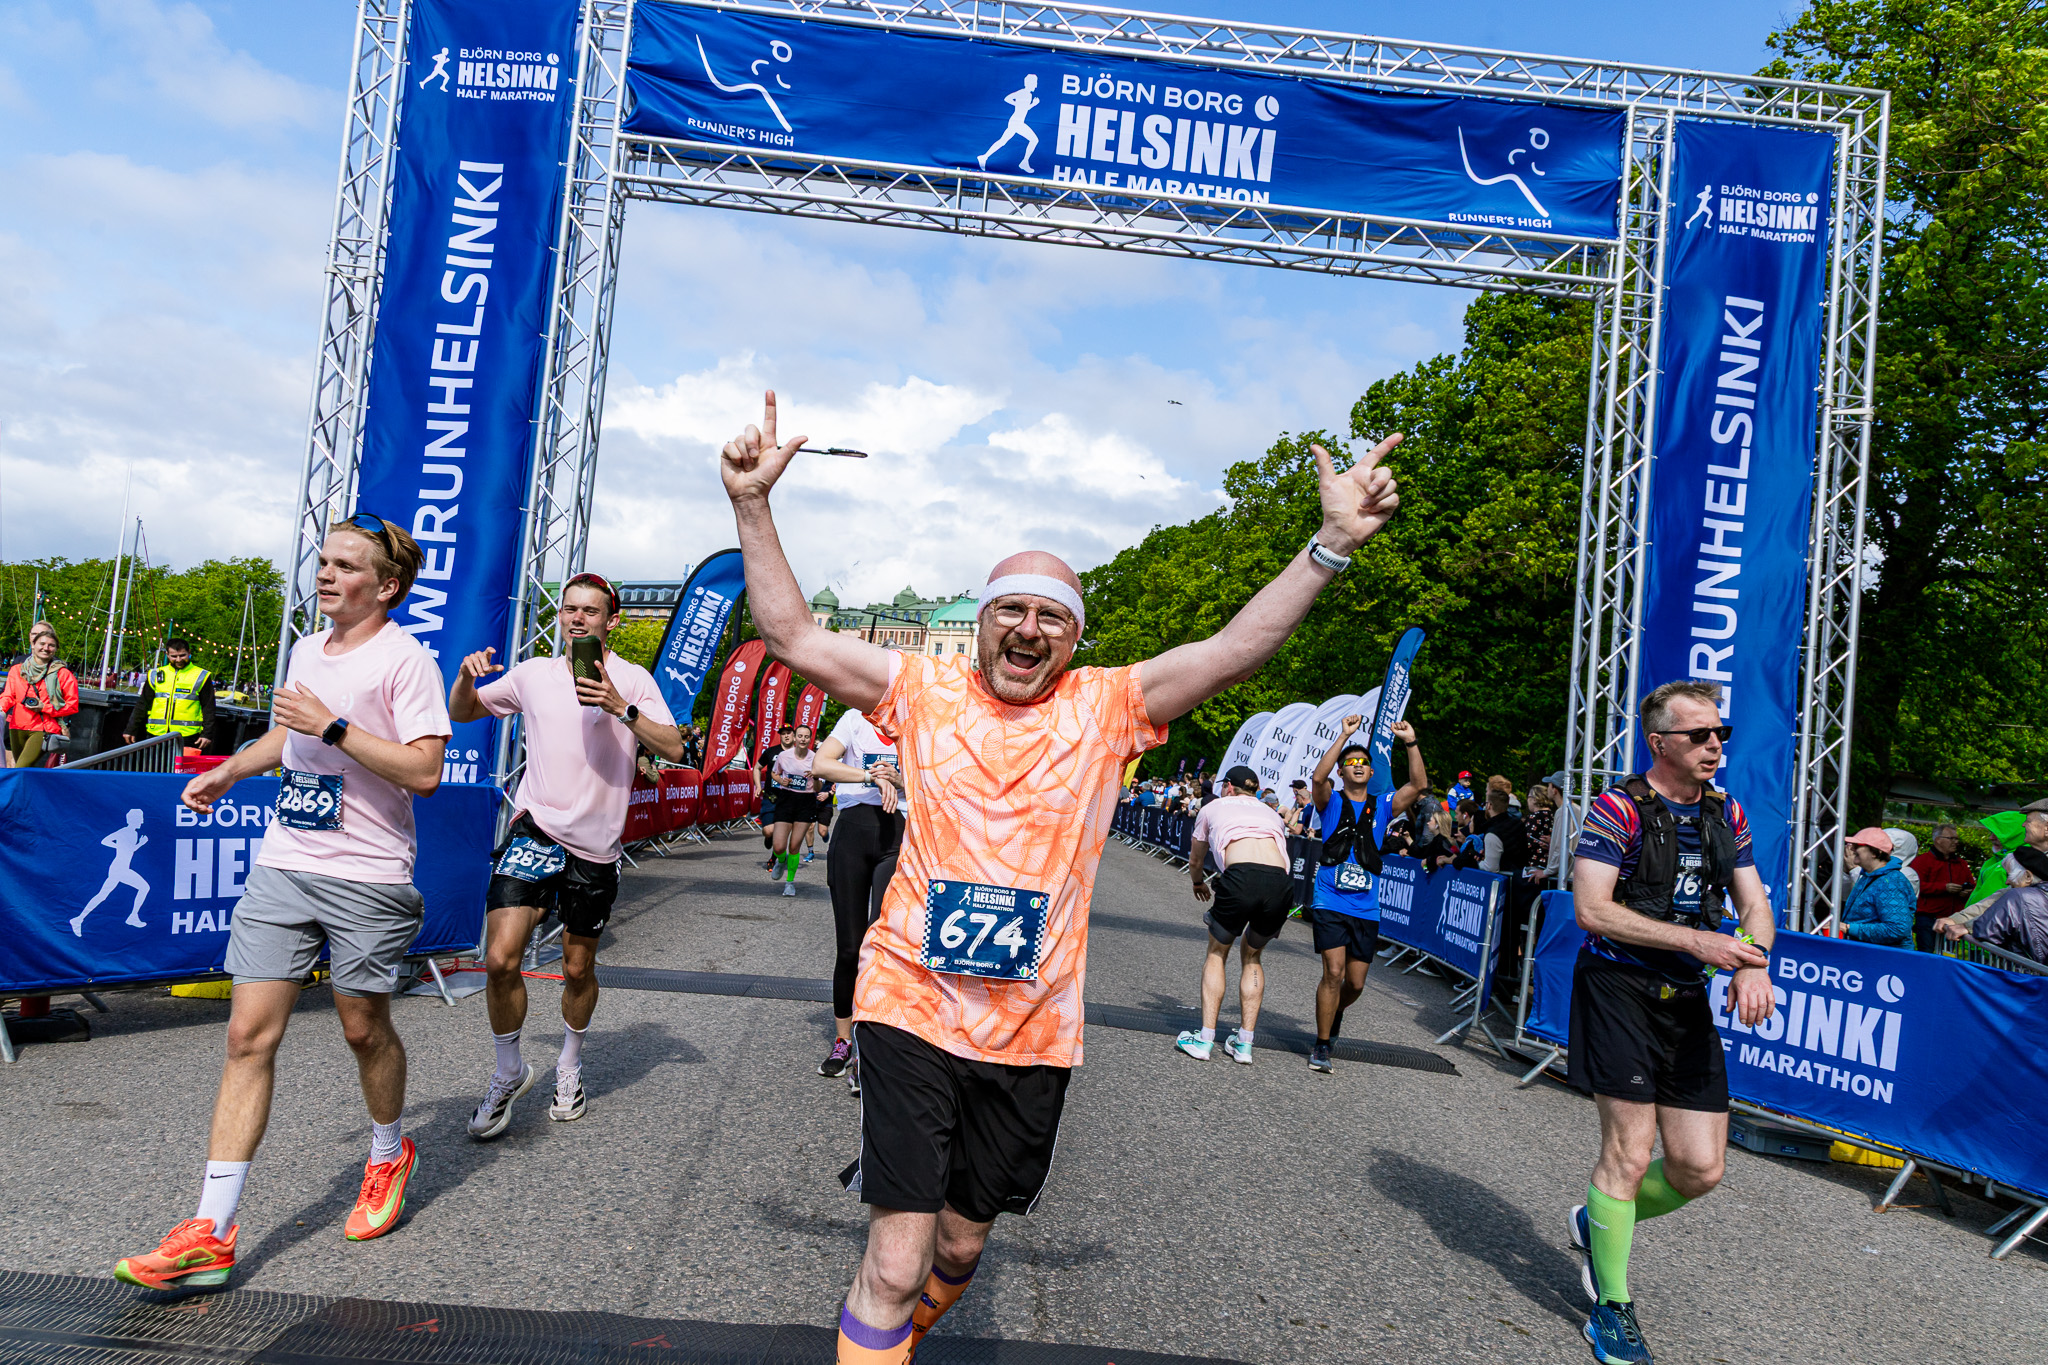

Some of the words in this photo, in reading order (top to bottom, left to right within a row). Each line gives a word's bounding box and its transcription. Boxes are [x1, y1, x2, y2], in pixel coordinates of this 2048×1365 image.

[460, 47, 502, 60] BJÖRN
[506, 50, 542, 62] BORG
[457, 60, 559, 91] HELSINKI
[456, 88, 487, 100] HALF
[490, 90, 555, 102] MARATHON
[1061, 72, 1156, 105] BJÖRN
[1163, 86, 1243, 116] BORG
[688, 117, 756, 140] RUNNER'S
[759, 131, 794, 147] HIGH
[1055, 103, 1277, 183] HELSINKI
[1052, 164, 1119, 190] HALF
[1126, 174, 1270, 205] MARATHON
[1721, 185, 1761, 199] BJÖRN
[1764, 191, 1801, 203] BORG
[1448, 212, 1515, 226] RUNNER'S
[1518, 217, 1552, 229] HIGH
[1719, 197, 1818, 231] HELSINKI
[1719, 224, 1748, 236] HALF
[1750, 228, 1815, 243] MARATHON
[668, 626, 687, 660] BJÖRN
[682, 598, 699, 626] BORG
[678, 589, 724, 668] HELSINKI
[699, 648, 712, 671] HALF
[708, 598, 733, 648] MARATHON
[716, 714, 733, 757] BJÖRN
[725, 676, 741, 713] BORG
[765, 689, 776, 719] BORG
[1242, 733, 1257, 749] Ru
[1313, 722, 1338, 741] Ru
[1263, 747, 1288, 763] you
[280, 785, 334, 817] 2869
[680, 786, 694, 799] BORG
[506, 847, 559, 873] 2875
[1340, 871, 1367, 888] 628
[1392, 868, 1409, 880] BORG
[973, 891, 1016, 907] HELSINKI
[974, 885, 993, 893] BJÖRN
[993, 887, 1009, 895] BORG
[1378, 877, 1414, 912] ELSINKI
[1451, 878, 1466, 895] BJÖRN
[1466, 883, 1480, 898] BORG
[986, 904, 1015, 913] MARATHON
[1381, 908, 1410, 926] MARATHON
[1447, 895, 1484, 937] HELSINKI
[171, 909, 232, 935] HAL
[940, 909, 1028, 959] 674
[954, 959, 976, 968] BJÖRN
[975, 960, 994, 969] BORG
[1778, 956, 1864, 993] BORG
[1739, 1043, 1894, 1105] MARATHON
